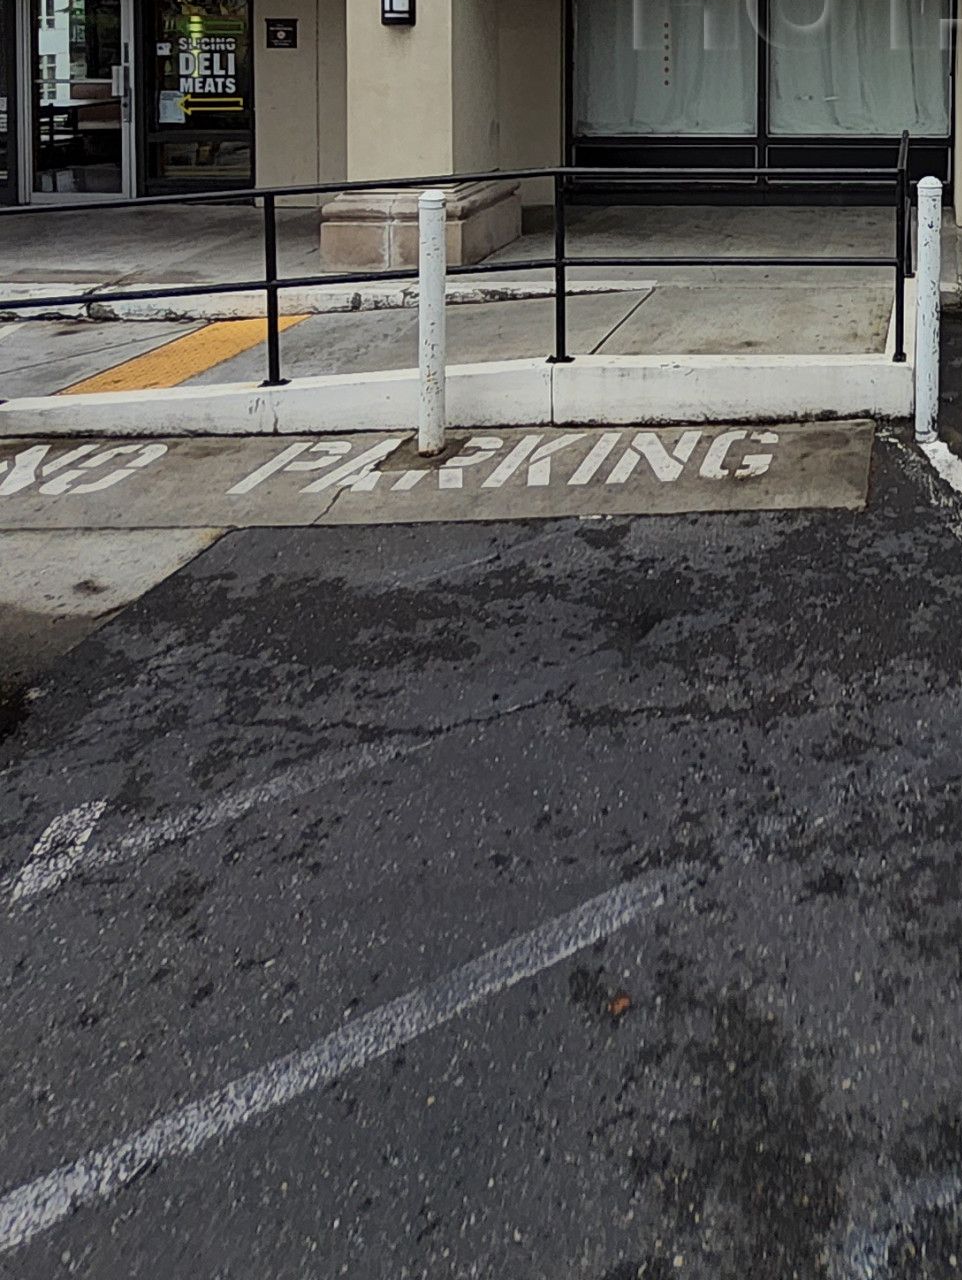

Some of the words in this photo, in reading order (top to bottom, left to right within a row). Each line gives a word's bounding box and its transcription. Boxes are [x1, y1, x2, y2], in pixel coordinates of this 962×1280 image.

[178, 52, 236, 76] DELI
[179, 77, 236, 93] MEATS
[225, 430, 779, 495] PARKING
